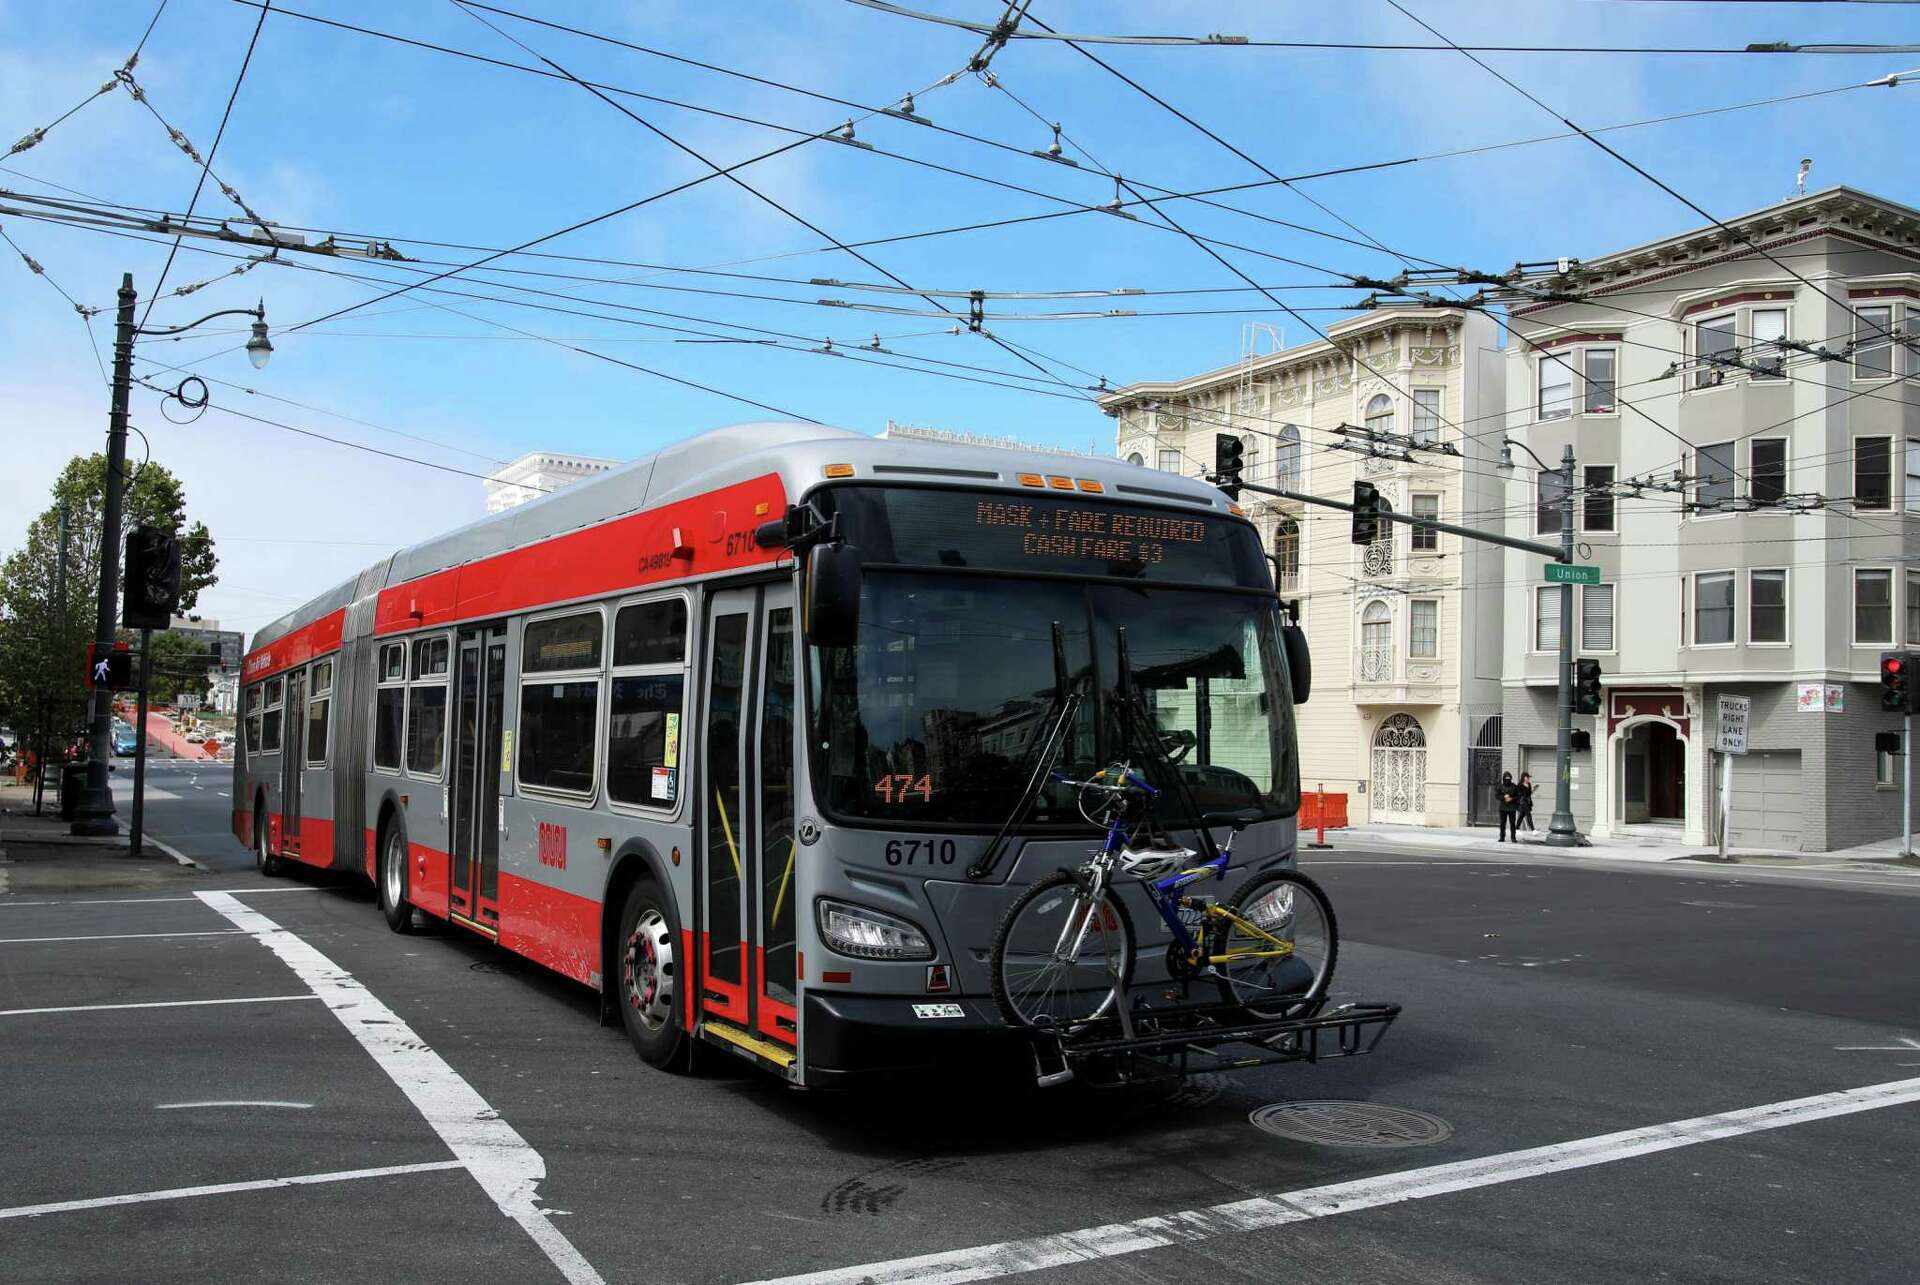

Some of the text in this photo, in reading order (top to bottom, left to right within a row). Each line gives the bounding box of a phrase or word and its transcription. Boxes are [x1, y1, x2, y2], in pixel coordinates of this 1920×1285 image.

[975, 501, 1032, 528] MASK
[1055, 509, 1107, 534] FARE
[1112, 514, 1206, 543] REQUIRED
[726, 529, 756, 556] 6710
[1023, 533, 1164, 563] CASH FARE $3
[1557, 568, 1588, 580] Union
[1720, 700, 1748, 712] TRUCKS
[1722, 713, 1745, 723] RIGHT
[1722, 725, 1743, 736] LANE
[1722, 737, 1742, 747] ONLY
[874, 774, 932, 803] 474
[885, 839, 956, 866] 6710
